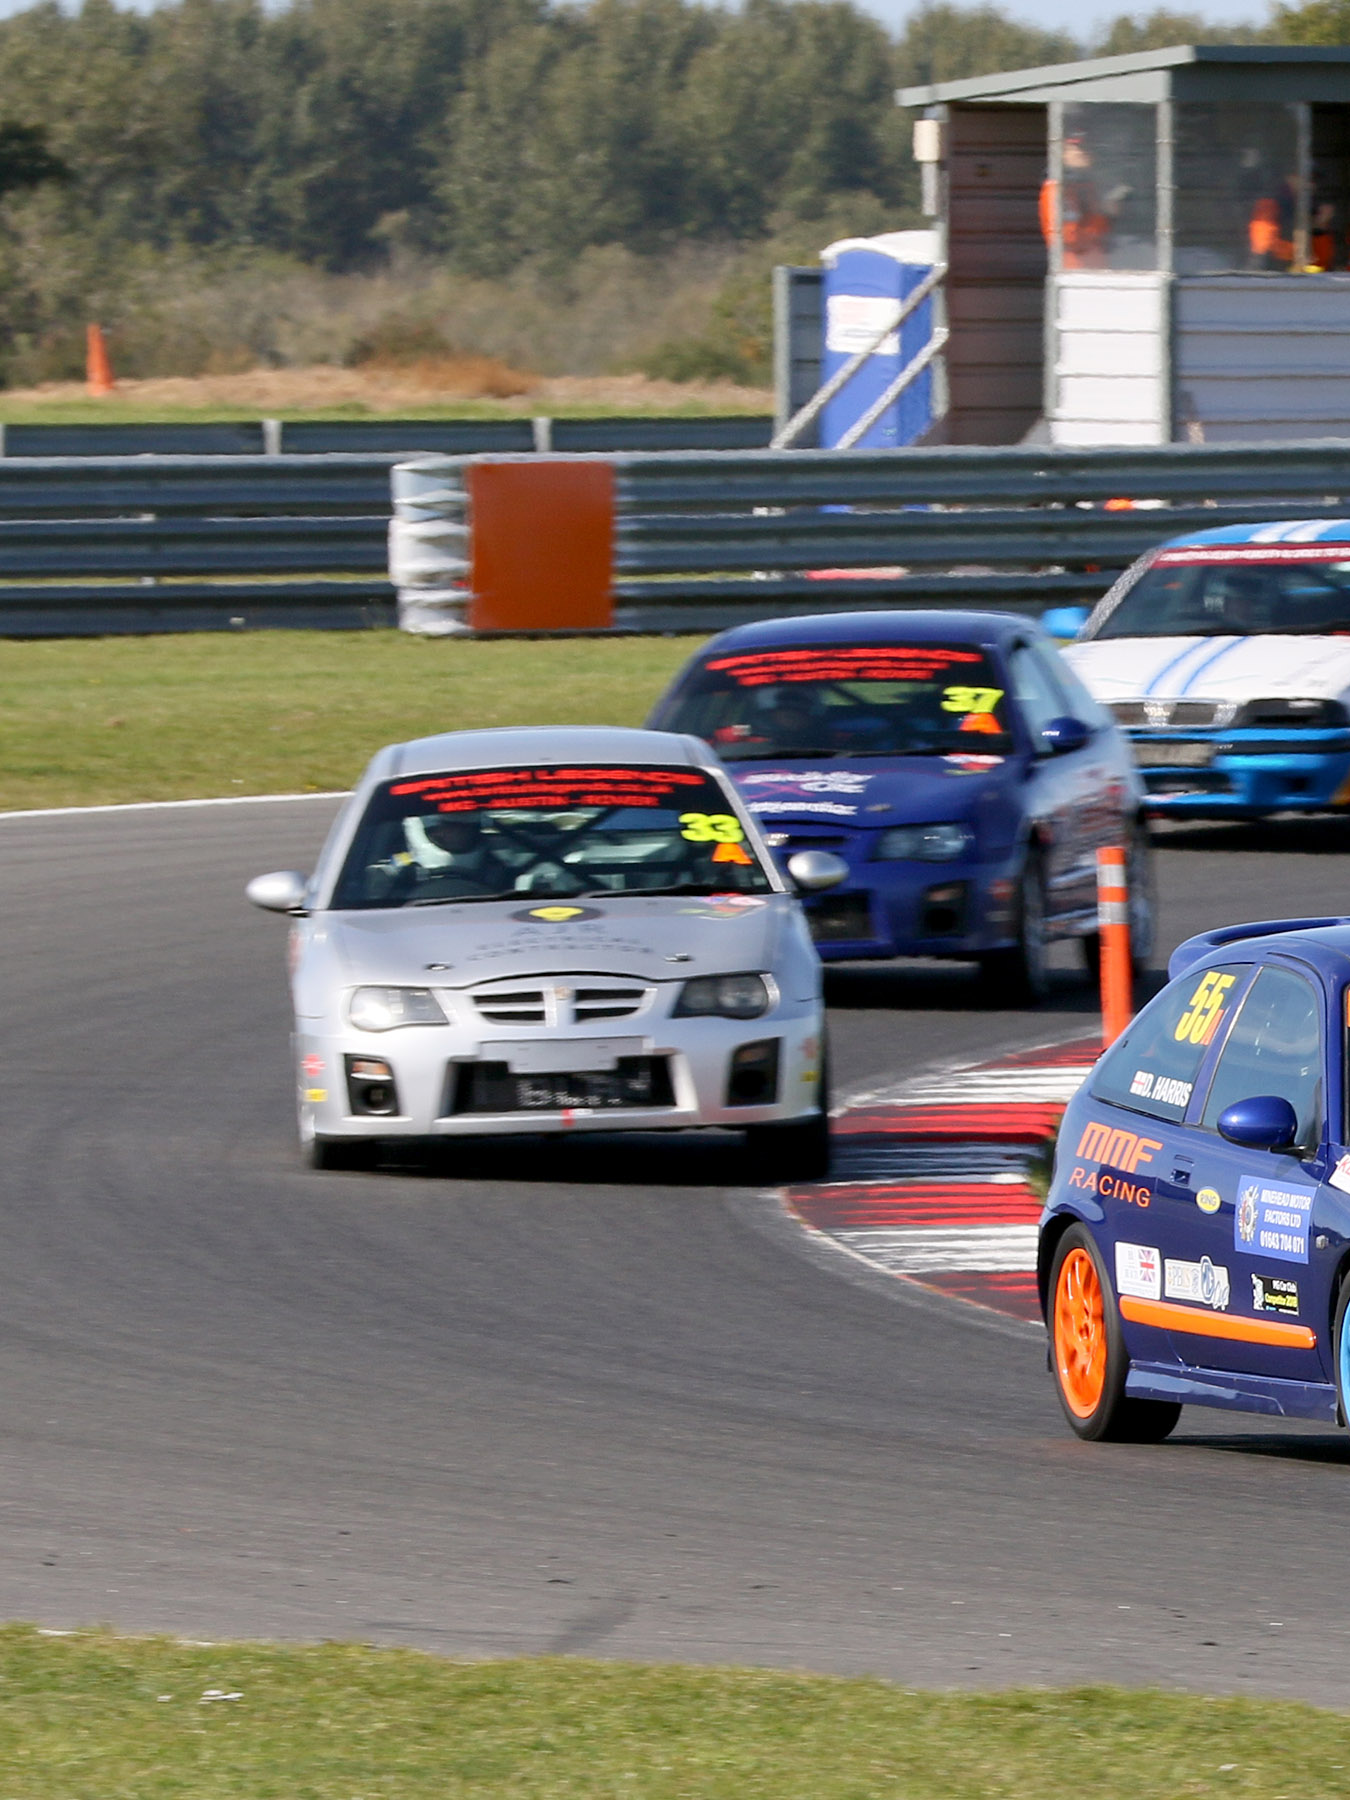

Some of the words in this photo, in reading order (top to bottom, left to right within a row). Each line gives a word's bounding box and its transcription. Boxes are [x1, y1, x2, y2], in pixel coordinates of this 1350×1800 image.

[940, 686, 1005, 713] 37
[678, 812, 745, 843] 33
[1174, 970, 1237, 1045] 55
[1151, 1075, 1193, 1108] HARRIS
[1068, 1166, 1150, 1208] RACING
[1288, 1192, 1312, 1211] MOTOR
[1263, 1208, 1291, 1227] FACTORS
[1290, 1213, 1302, 1229] LTD
